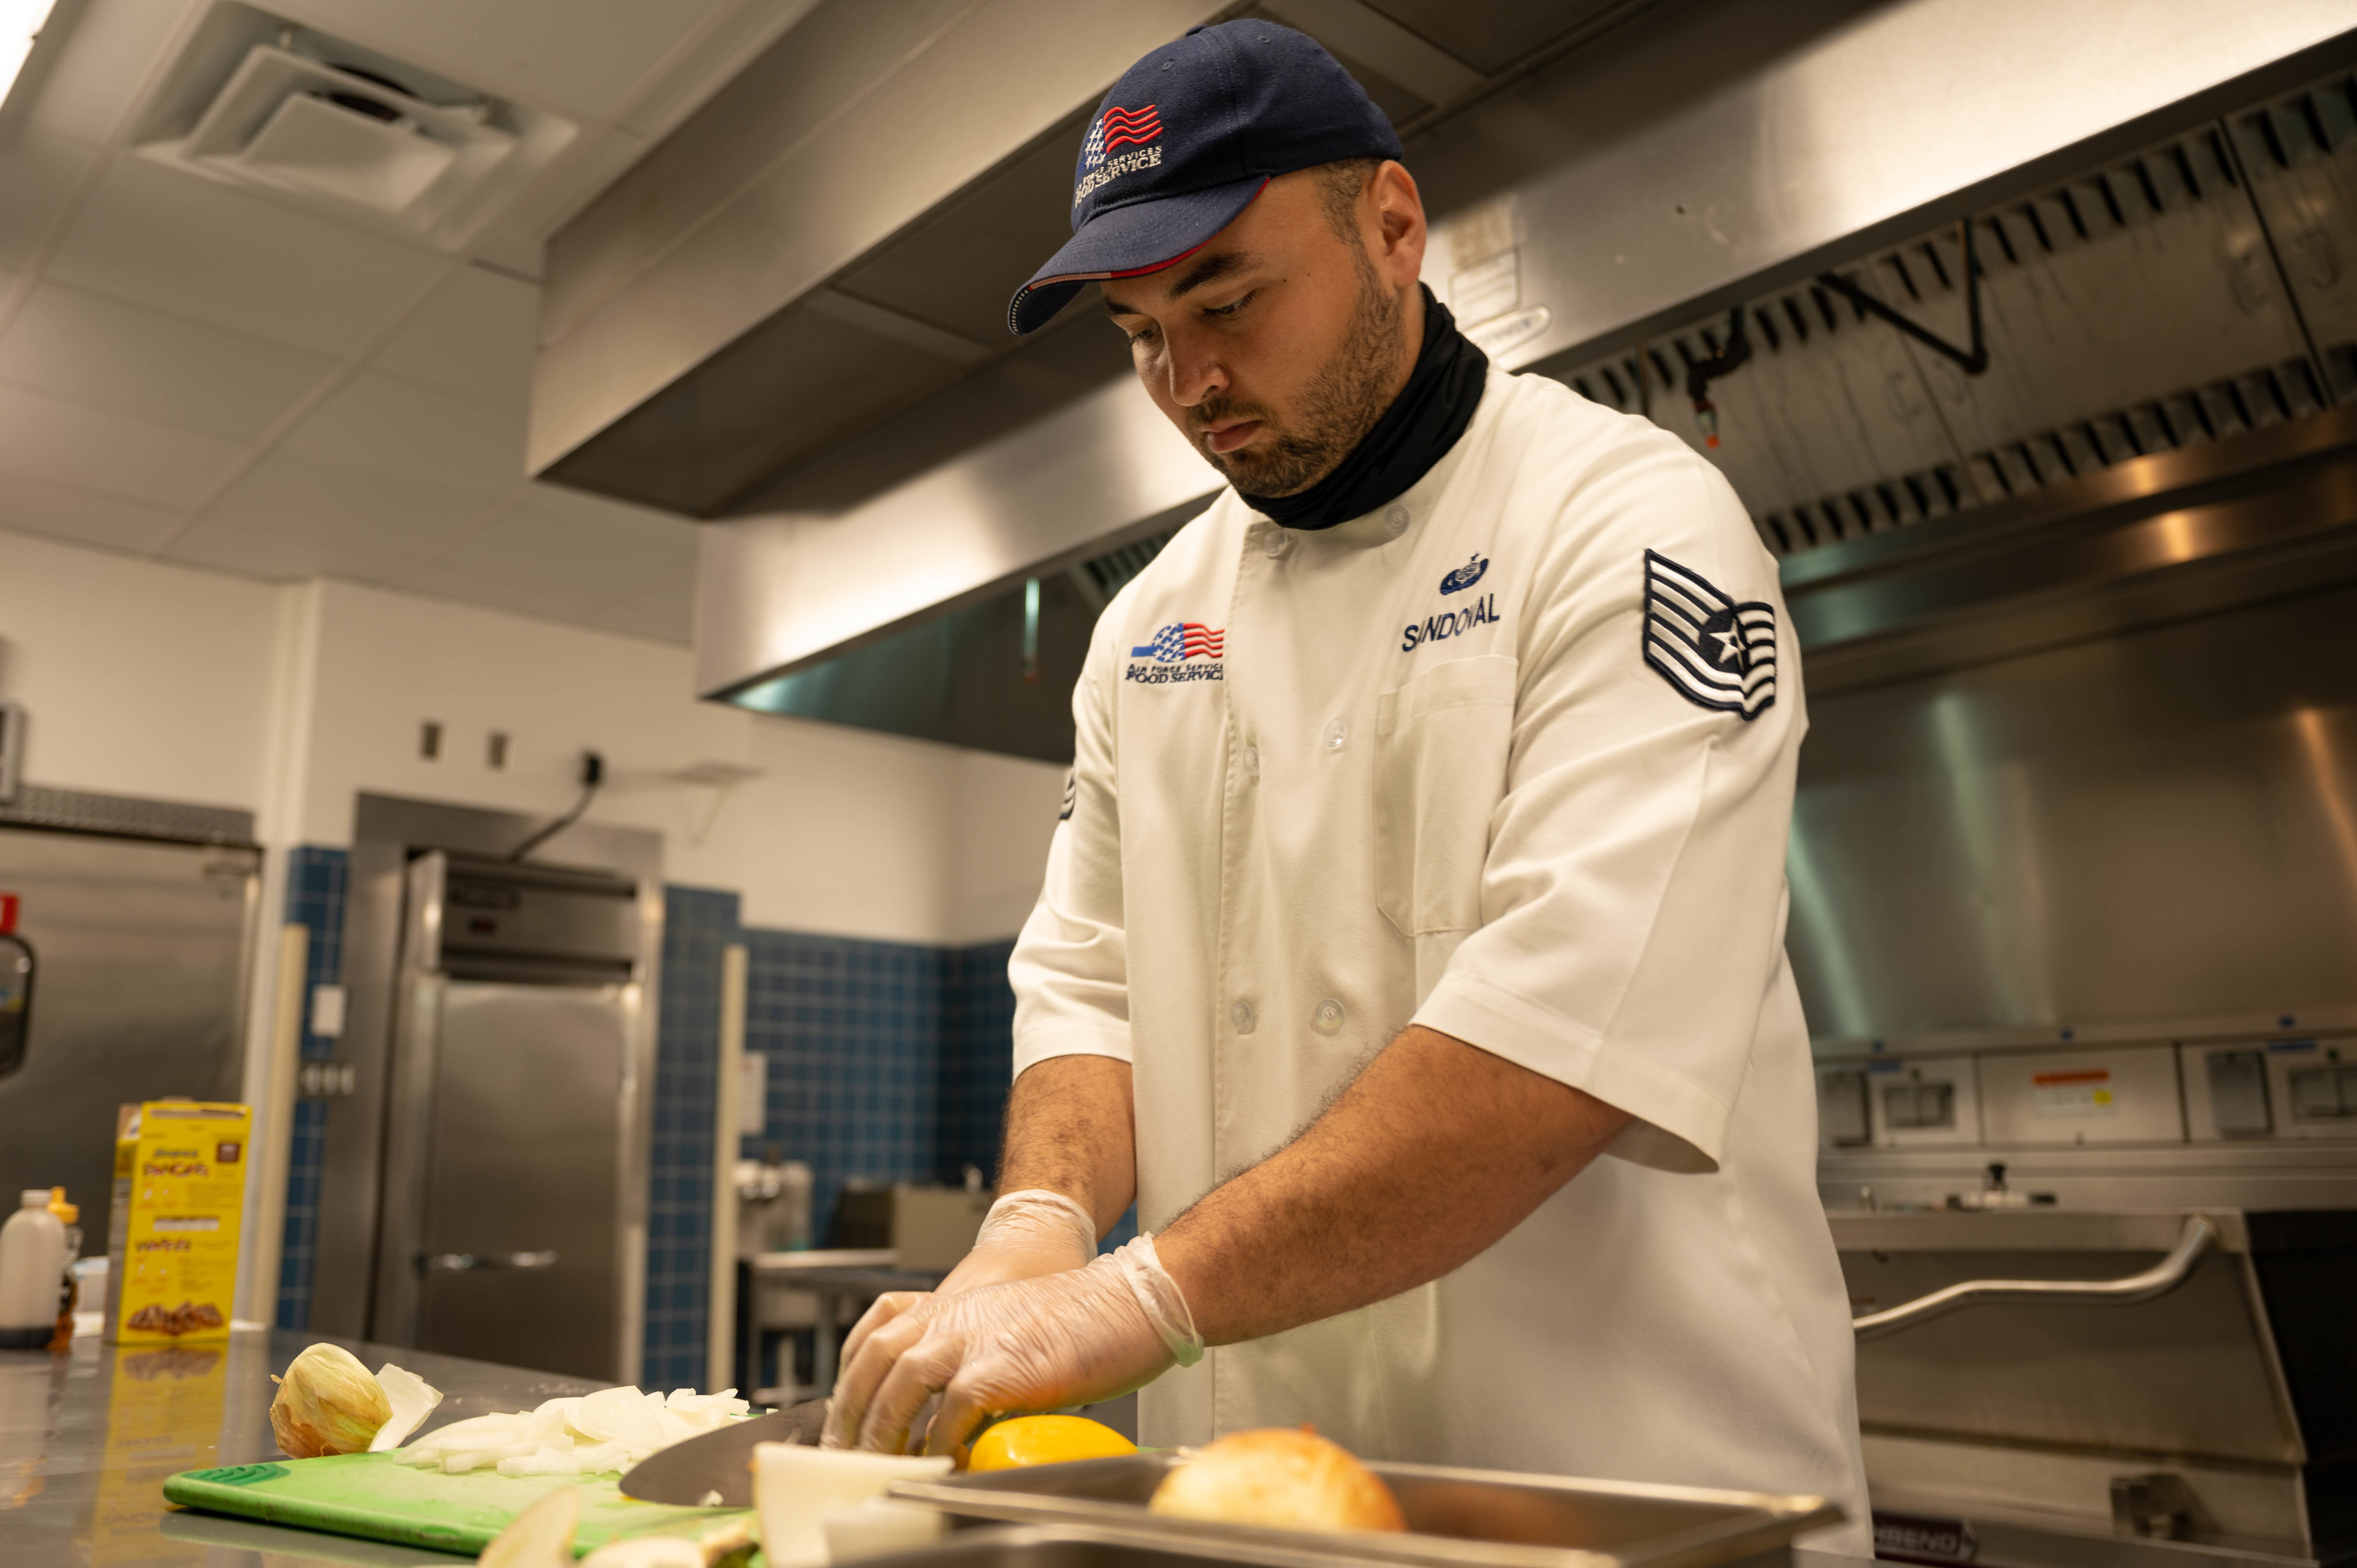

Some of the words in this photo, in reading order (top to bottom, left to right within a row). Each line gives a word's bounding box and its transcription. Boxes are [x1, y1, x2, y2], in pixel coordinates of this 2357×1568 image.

[1107, 146, 1162, 169] SERVICES
[1095, 154, 1161, 189] SERVICE
[1125, 671, 1168, 684] FOOD
[1129, 664, 1147, 673] AIR
